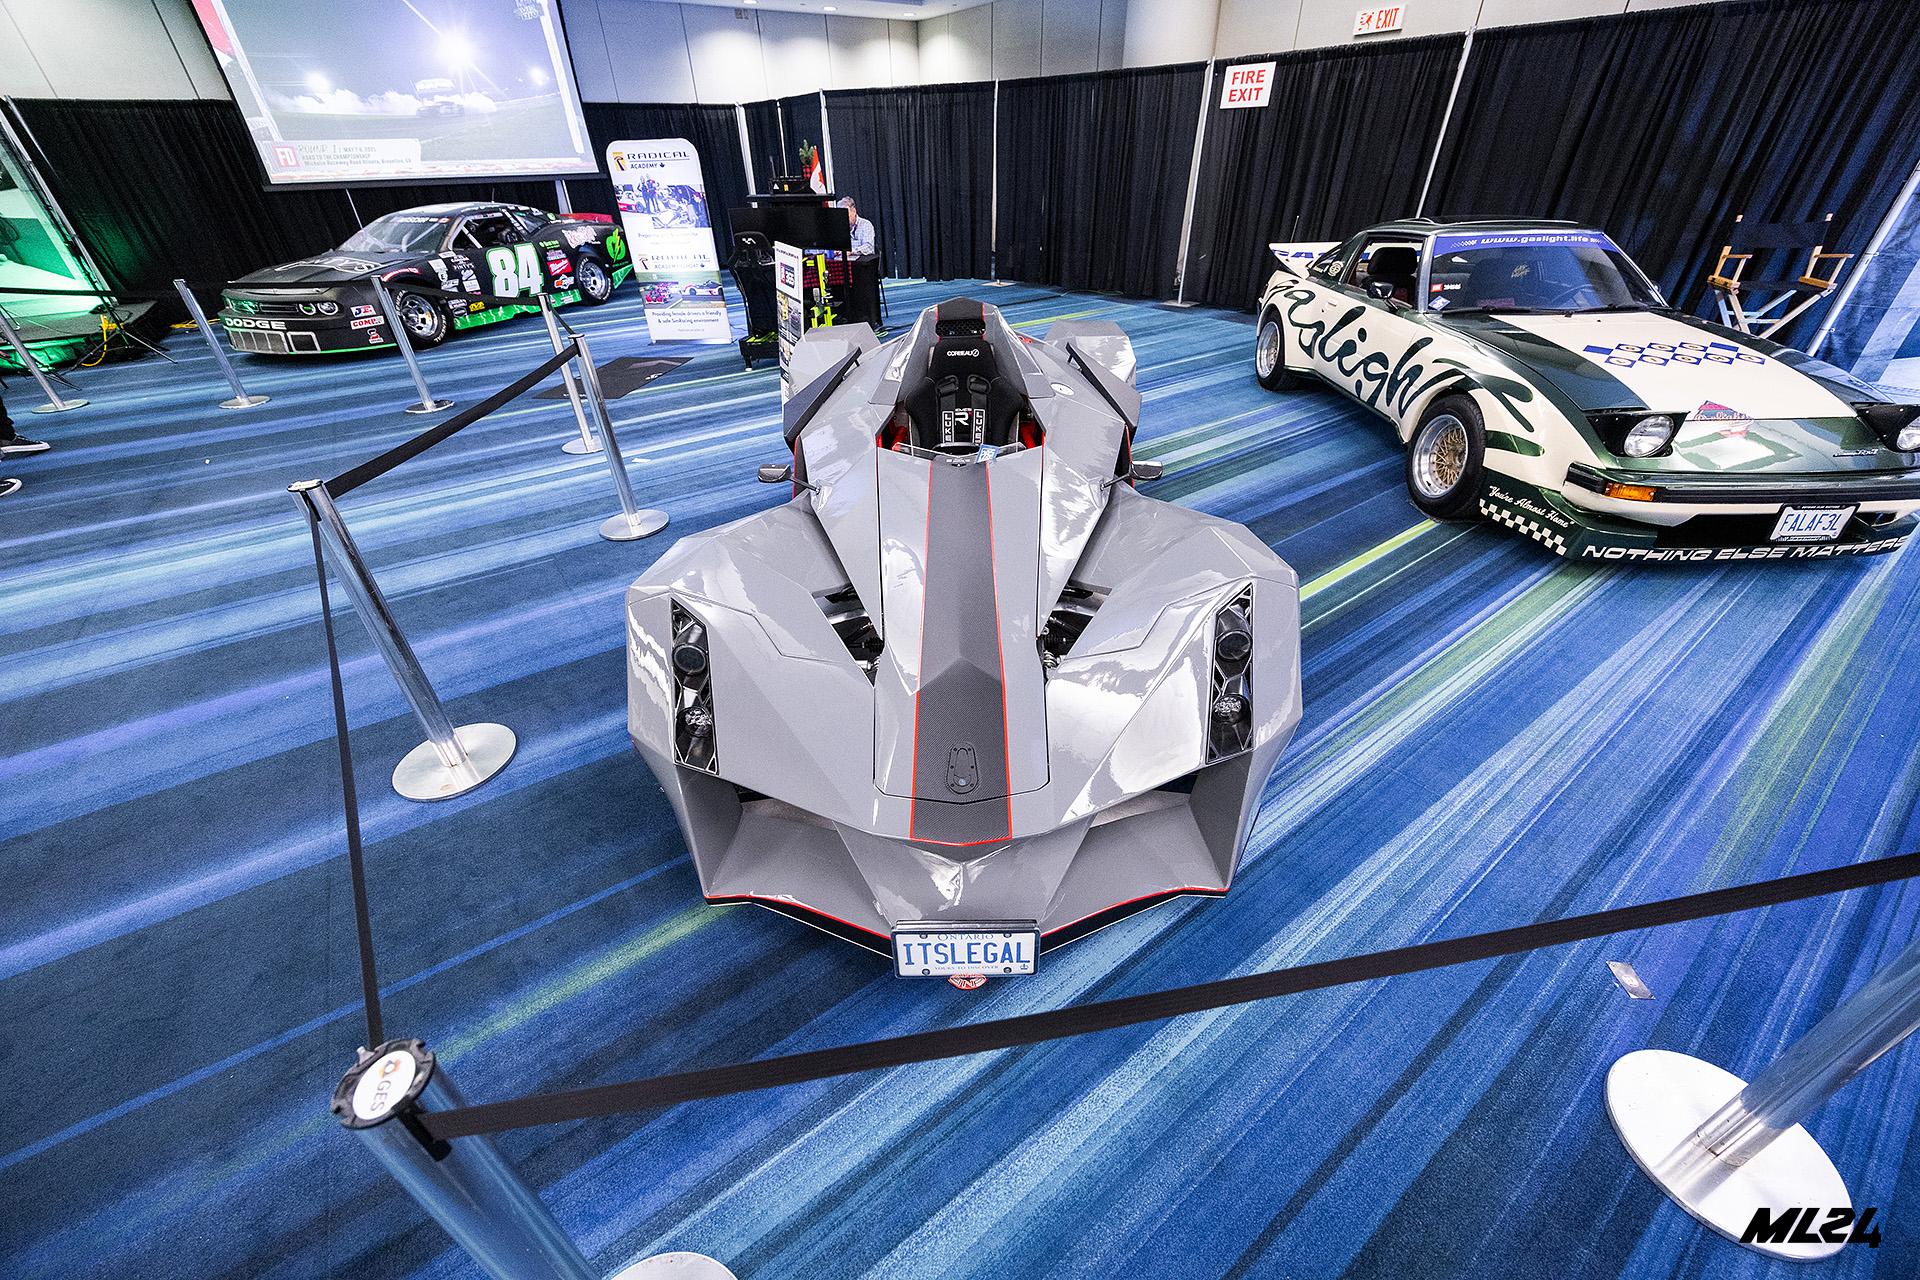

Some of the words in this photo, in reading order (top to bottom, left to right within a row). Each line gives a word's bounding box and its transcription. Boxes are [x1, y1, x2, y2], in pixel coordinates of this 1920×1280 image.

[1375, 8, 1400, 30] EXIT
[1231, 69, 1266, 85] FIRE
[1228, 87, 1263, 103] EXIT
[627, 151, 690, 160] RADICAL
[1481, 235, 1589, 244] www.gaslight.life
[485, 244, 545, 299] 84
[224, 318, 287, 330] DODGE
[1514, 498, 1546, 516] Almost
[1780, 513, 1842, 532] FALAF3L
[1581, 545, 1708, 562] NOTHING
[1713, 547, 1790, 561] ELSE
[1790, 535, 1909, 559] MATTERS
[937, 933, 994, 941] ONTARIO
[903, 942, 1031, 966] ITSLEGAL
[370, 1080, 392, 1112] GES
